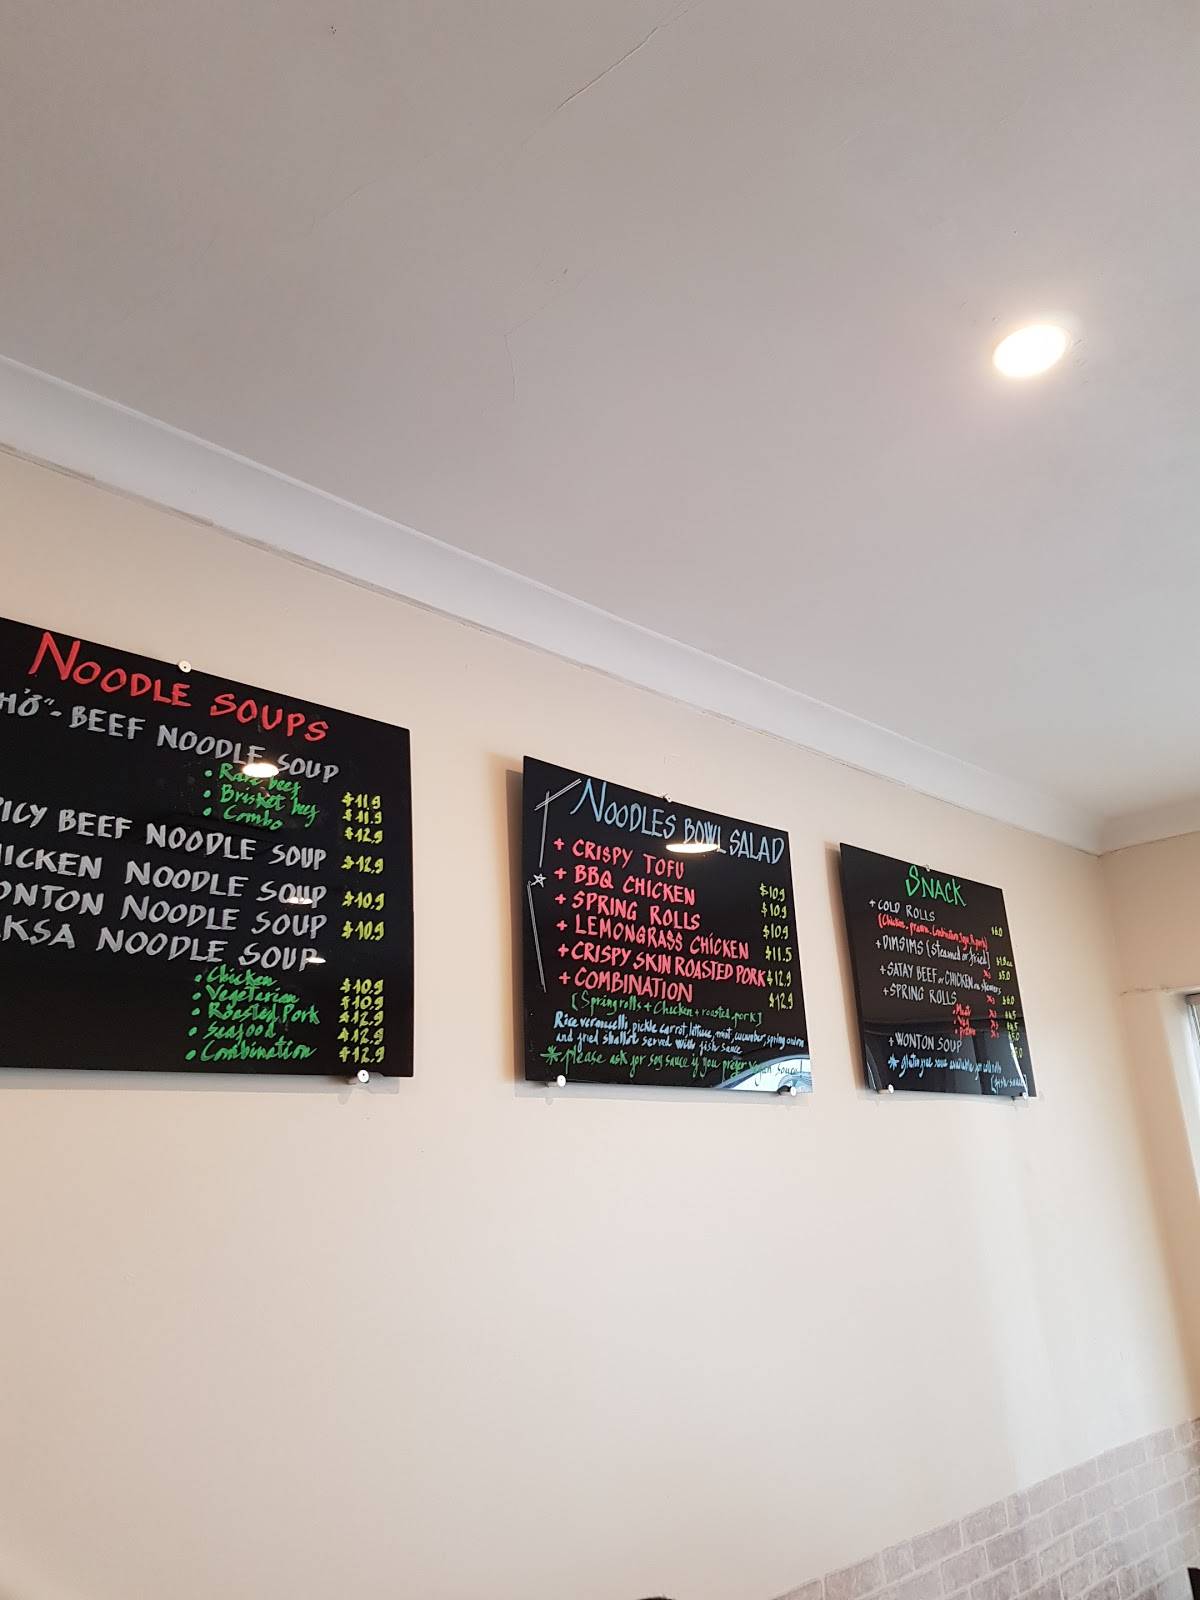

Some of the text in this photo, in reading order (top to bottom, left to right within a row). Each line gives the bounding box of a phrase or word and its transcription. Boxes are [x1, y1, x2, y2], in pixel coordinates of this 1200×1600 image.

[28, 631, 329, 742] NOODLE SOUPS
[69, 705, 146, 740] BEEF
[157, 725, 266, 765] NOODLE
[277, 753, 340, 784] SOUP
[220, 784, 383, 828] Brisket beef $11.9
[268, 777, 302, 799] beef
[342, 791, 382, 811] $11.9
[58, 809, 133, 840] BEEF
[146, 823, 257, 861] NOODLE
[268, 844, 327, 871] SOUP
[341, 855, 384, 875] $12.9
[223, 804, 384, 844] Combo $12.9
[570, 778, 785, 865] NOODLES BOWL SALAD
[0, 843, 385, 911] ICKEN NOODLE SOUP $10.9
[572, 839, 786, 902] CRISPY TOFU $10.9
[905, 863, 967, 908] SNACK
[574, 865, 787, 919] BBQ CHICKEN $10.9
[878, 899, 936, 922] COLD ROLLS
[120, 895, 241, 931] NOODLE
[251, 911, 328, 939] SOUP
[342, 920, 385, 941] $10.9
[571, 890, 789, 940] SPRING ROLLS $10.9
[0, 915, 319, 972] KSA NOODLE SOUP
[575, 913, 793, 962] LEMONGRASS CHICKEN $11.5
[882, 934, 924, 956] DIMSIMS
[206, 964, 384, 995] Chicken $10.9
[571, 940, 792, 988] CRISPY SKIN ROASTED PORK $12.9
[886, 960, 914, 979] SATAY
[916, 965, 938, 984] BEEF
[945, 970, 974, 991] CHICKEN
[340, 995, 384, 1012] $10.9
[574, 966, 794, 1011] COMBINATION $12.9
[889, 983, 958, 1006] SPRING ROLLS
[203, 1021, 384, 1046] Seafood $12.9
[208, 1001, 384, 1027] Roasted Pork $12.9
[553, 1010, 579, 1029] Rice
[200, 1036, 385, 1063] Combination $12.9
[556, 1028, 573, 1042] and
[577, 1028, 599, 1053] fried
[641, 1036, 673, 1047] served
[675, 1039, 696, 1050] with
[699, 1041, 721, 1057] fish
[610, 1049, 628, 1065] ask
[629, 1054, 647, 1078] for
[648, 1053, 663, 1071] soy
[665, 1054, 690, 1068] sauce
[700, 1057, 721, 1078] you
[895, 1031, 935, 1051] WONTON
[937, 1036, 963, 1054] SOUP
